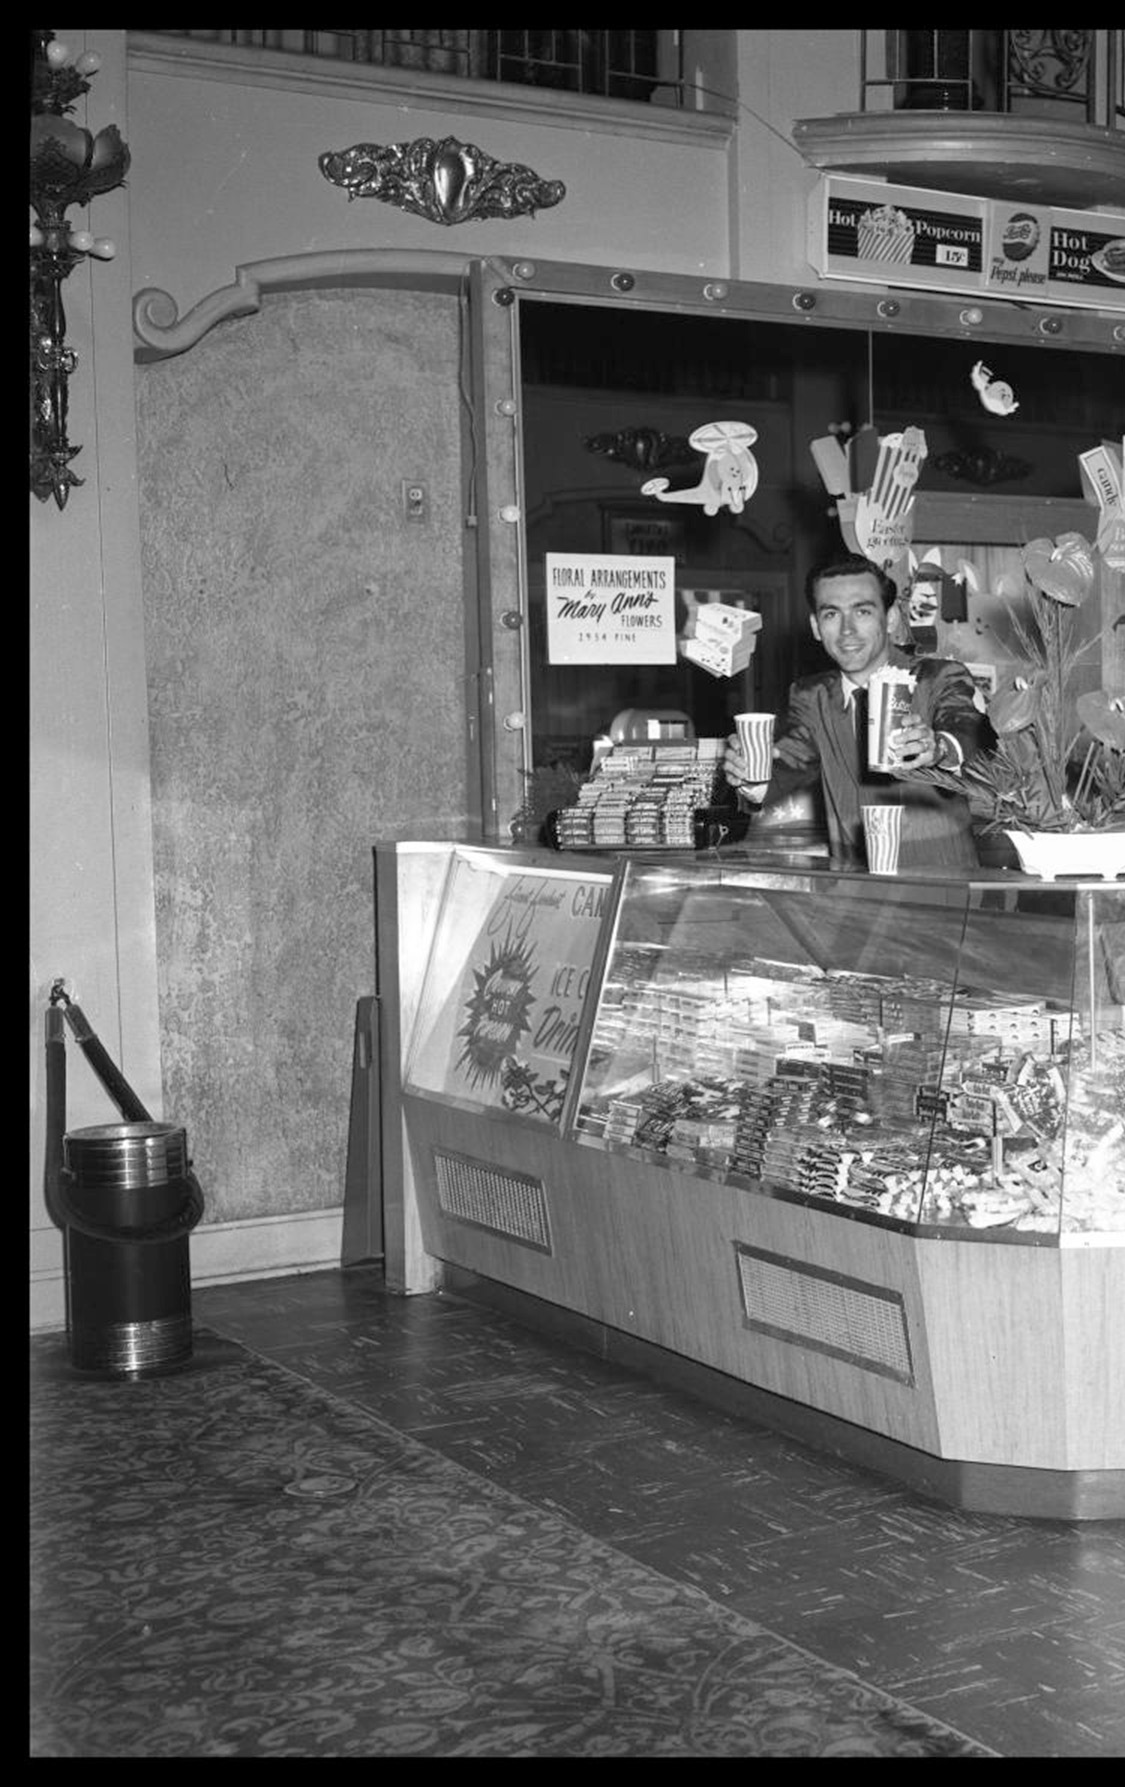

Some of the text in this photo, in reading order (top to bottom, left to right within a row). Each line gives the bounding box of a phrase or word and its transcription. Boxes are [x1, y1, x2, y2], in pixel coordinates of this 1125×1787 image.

[829, 209, 857, 227] Hot
[915, 220, 981, 243] Popcorn
[1053, 230, 1088, 251] Hot
[1053, 251, 1090, 273] Dog
[552, 567, 667, 590] FLORAL ARRANGEMENTS
[584, 589, 597, 600] by
[557, 591, 659, 624] Mary Ann's
[621, 614, 663, 629] FLOWERS
[615, 632, 637, 643] PINE
[551, 966, 576, 998] ICE
